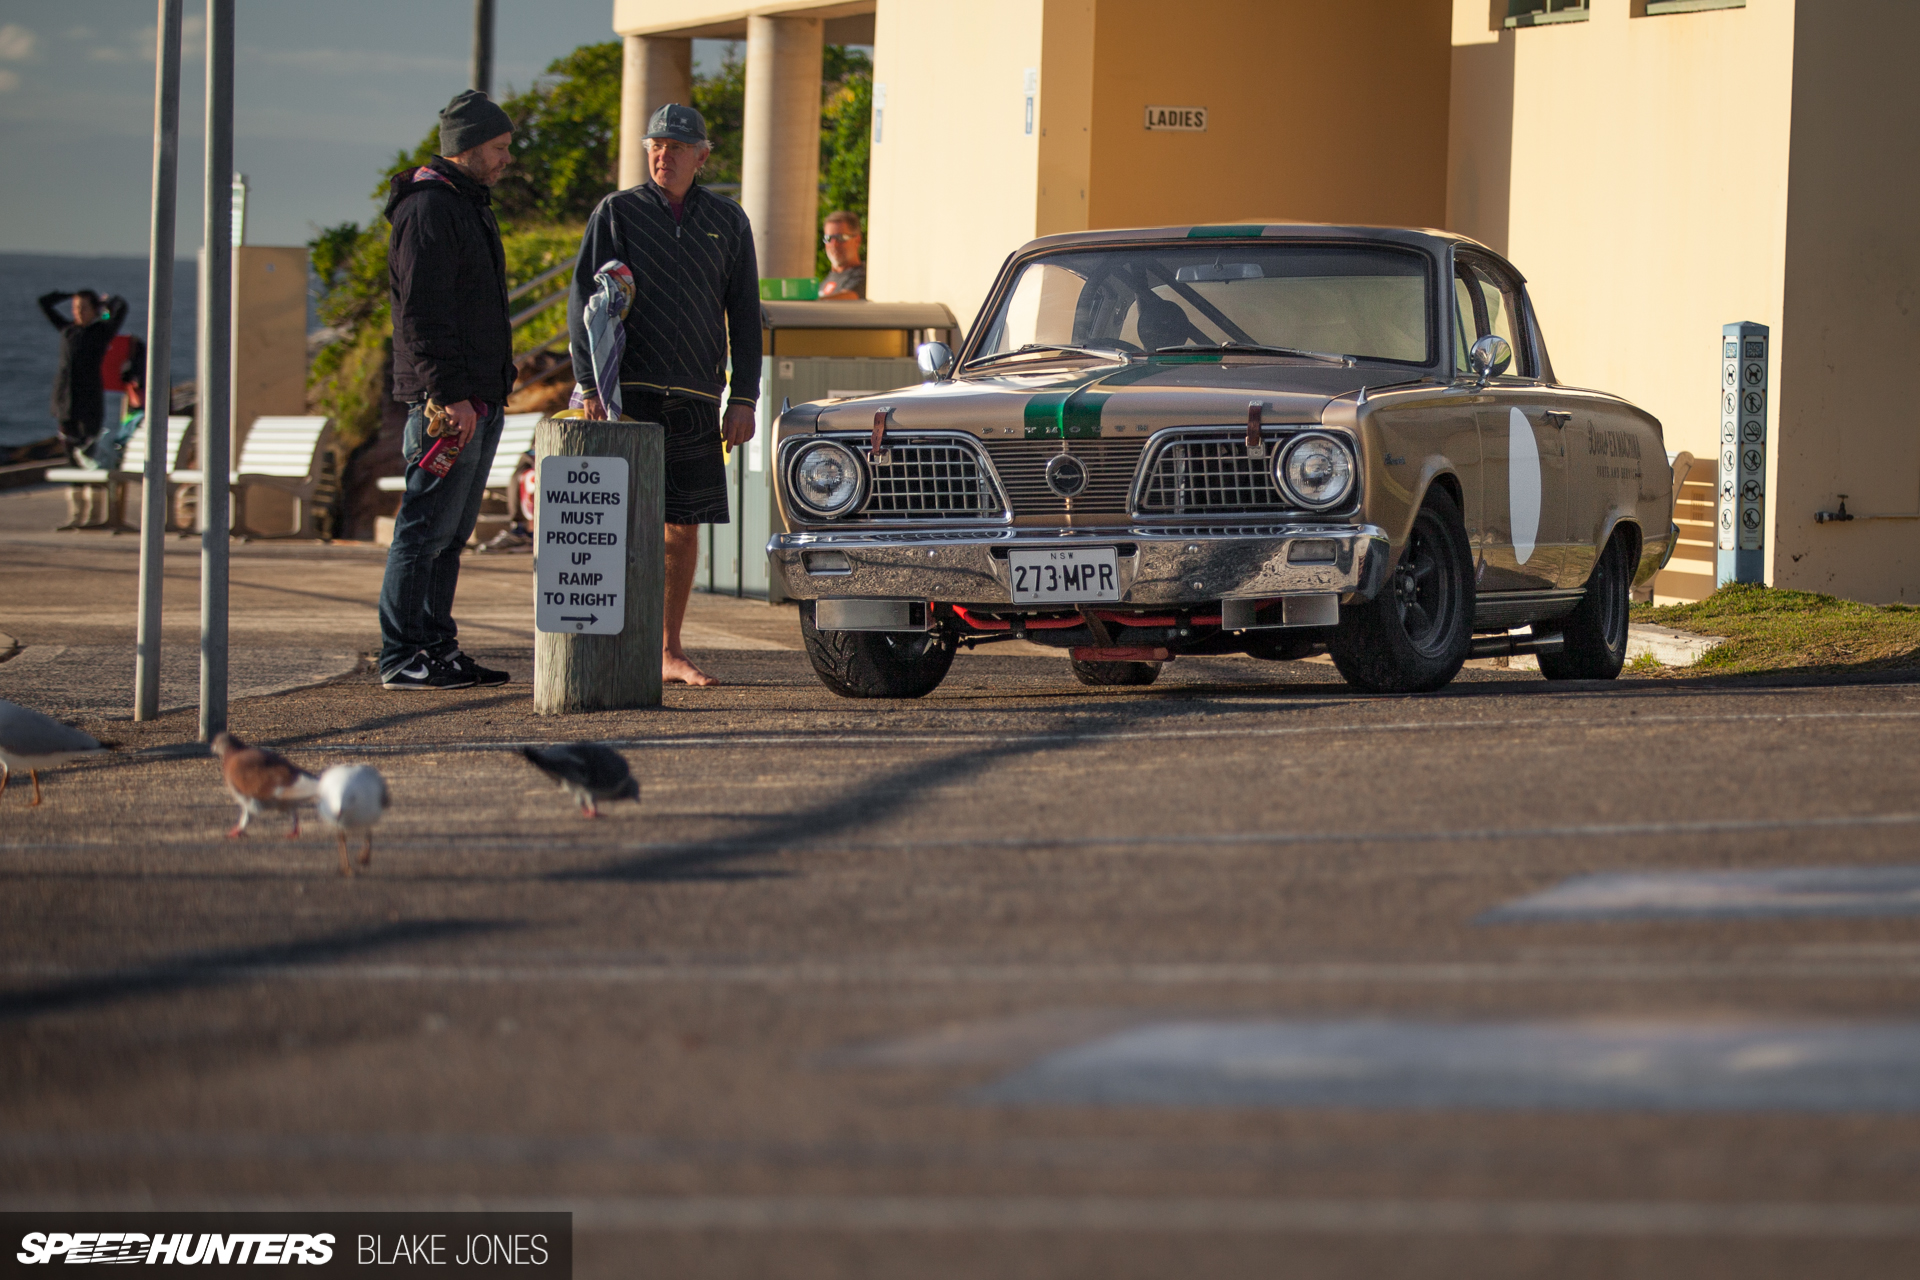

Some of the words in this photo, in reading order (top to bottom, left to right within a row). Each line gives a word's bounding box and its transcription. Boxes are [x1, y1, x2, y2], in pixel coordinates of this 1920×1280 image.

[1148, 110, 1204, 127] LADIES
[567, 470, 600, 484] DOG
[546, 490, 621, 505] WALKERS
[561, 511, 604, 525] MUST
[546, 531, 617, 546] PROCEED
[571, 552, 591, 565] UP
[1050, 552, 1074, 560] NSW
[558, 572, 603, 586] RAMP
[544, 592, 565, 605] TO
[569, 592, 617, 607] RIGHT
